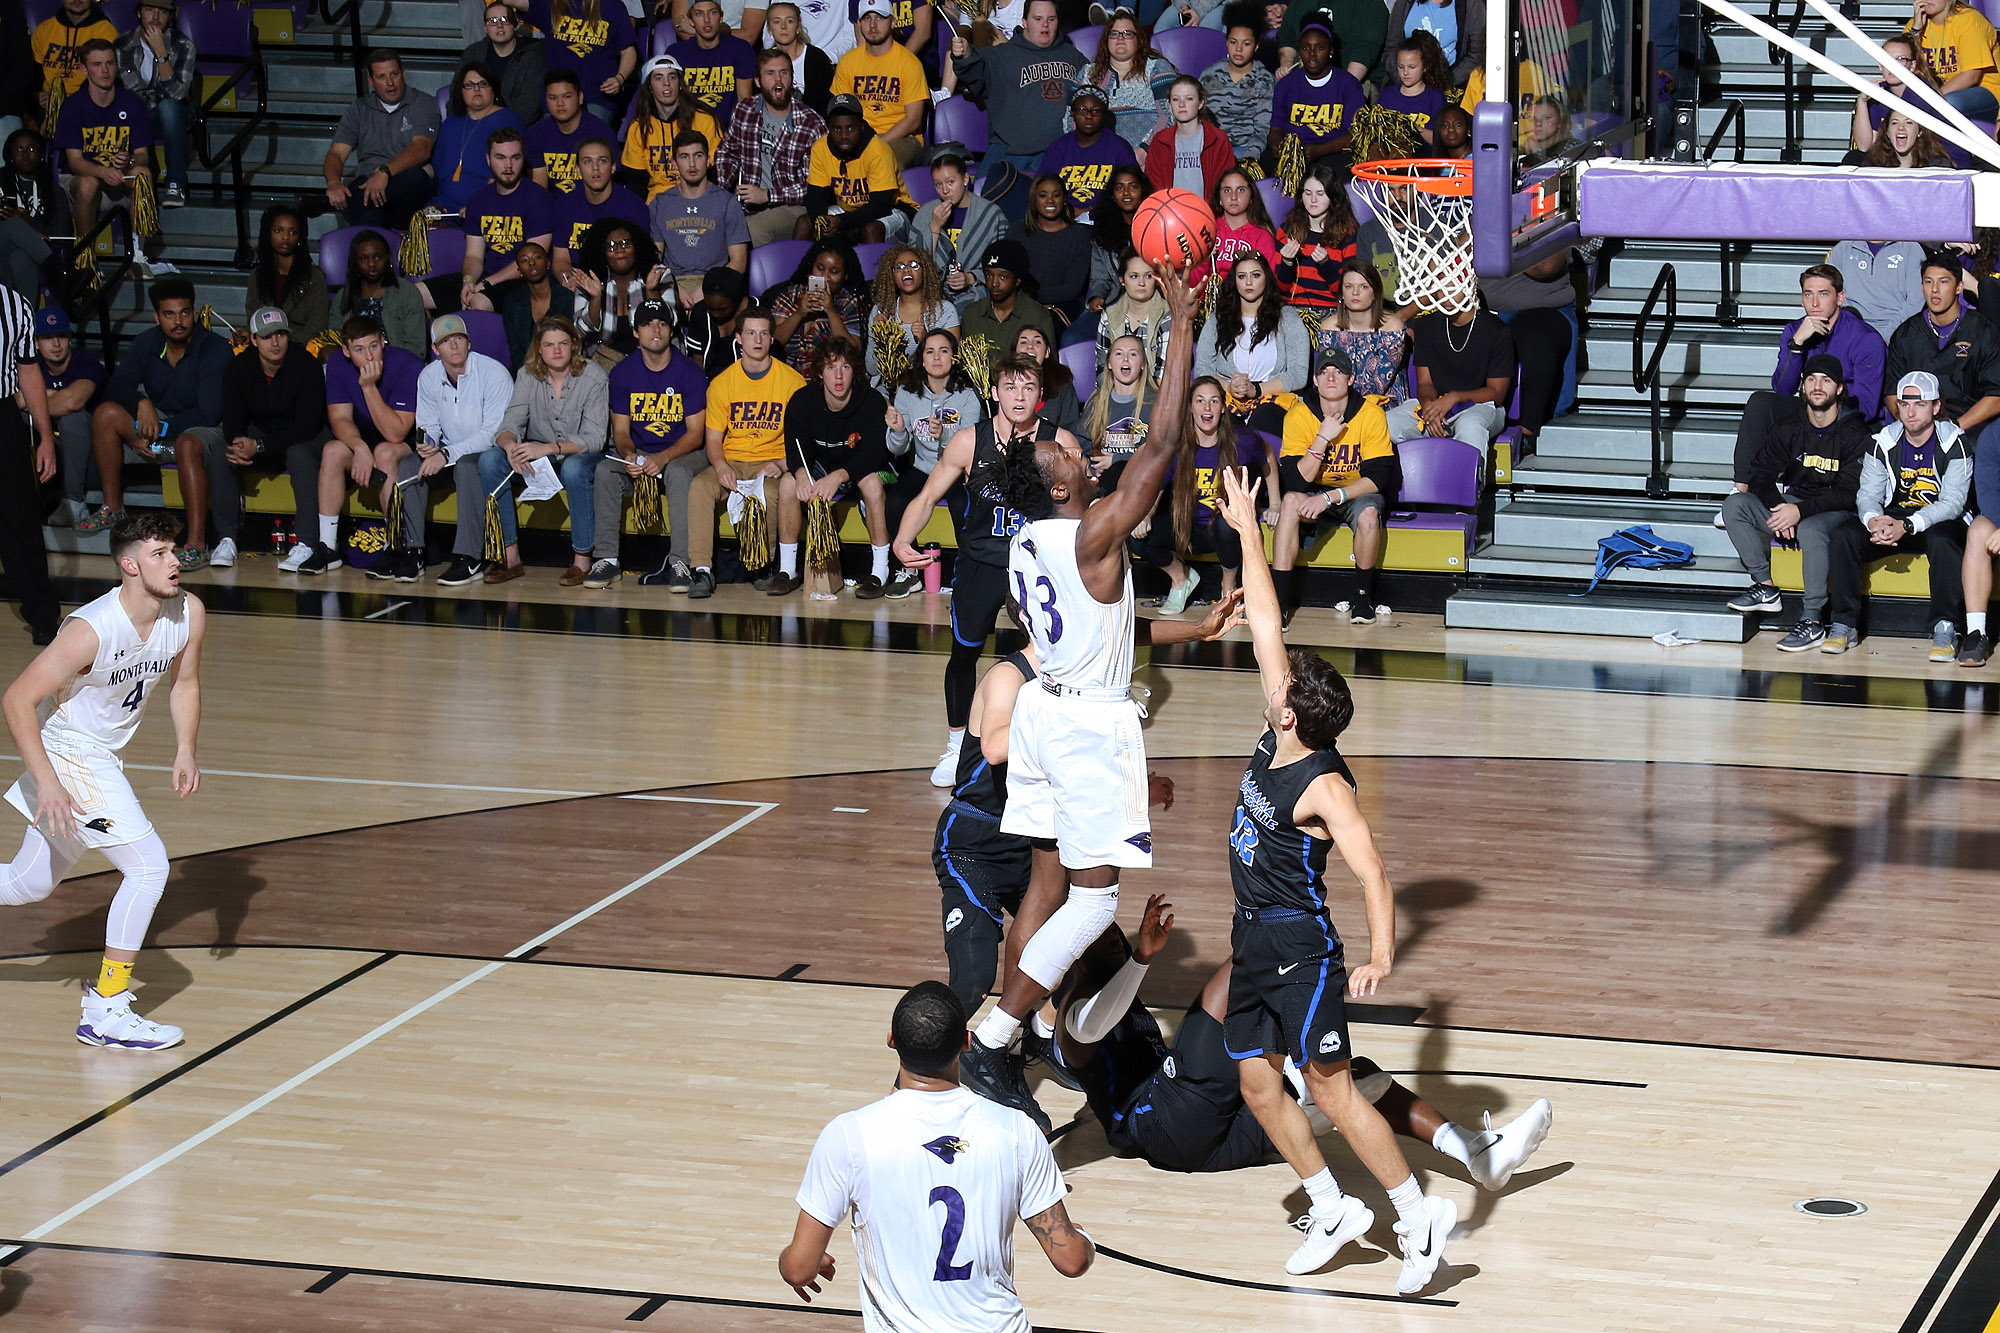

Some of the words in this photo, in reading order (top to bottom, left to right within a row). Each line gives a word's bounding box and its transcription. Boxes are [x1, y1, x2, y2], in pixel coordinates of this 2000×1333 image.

[684, 66, 735, 87] FEAR
[853, 76, 901, 97] FEAR
[630, 392, 685, 415] FEAR
[730, 402, 784, 423] FEAR
[649, 413, 684, 423] FALCONS
[991, 506, 1028, 537] 13
[1013, 570, 1064, 645] 13
[121, 680, 145, 712] 4
[1229, 804, 1260, 868] 12
[928, 1185, 975, 1281] 2
